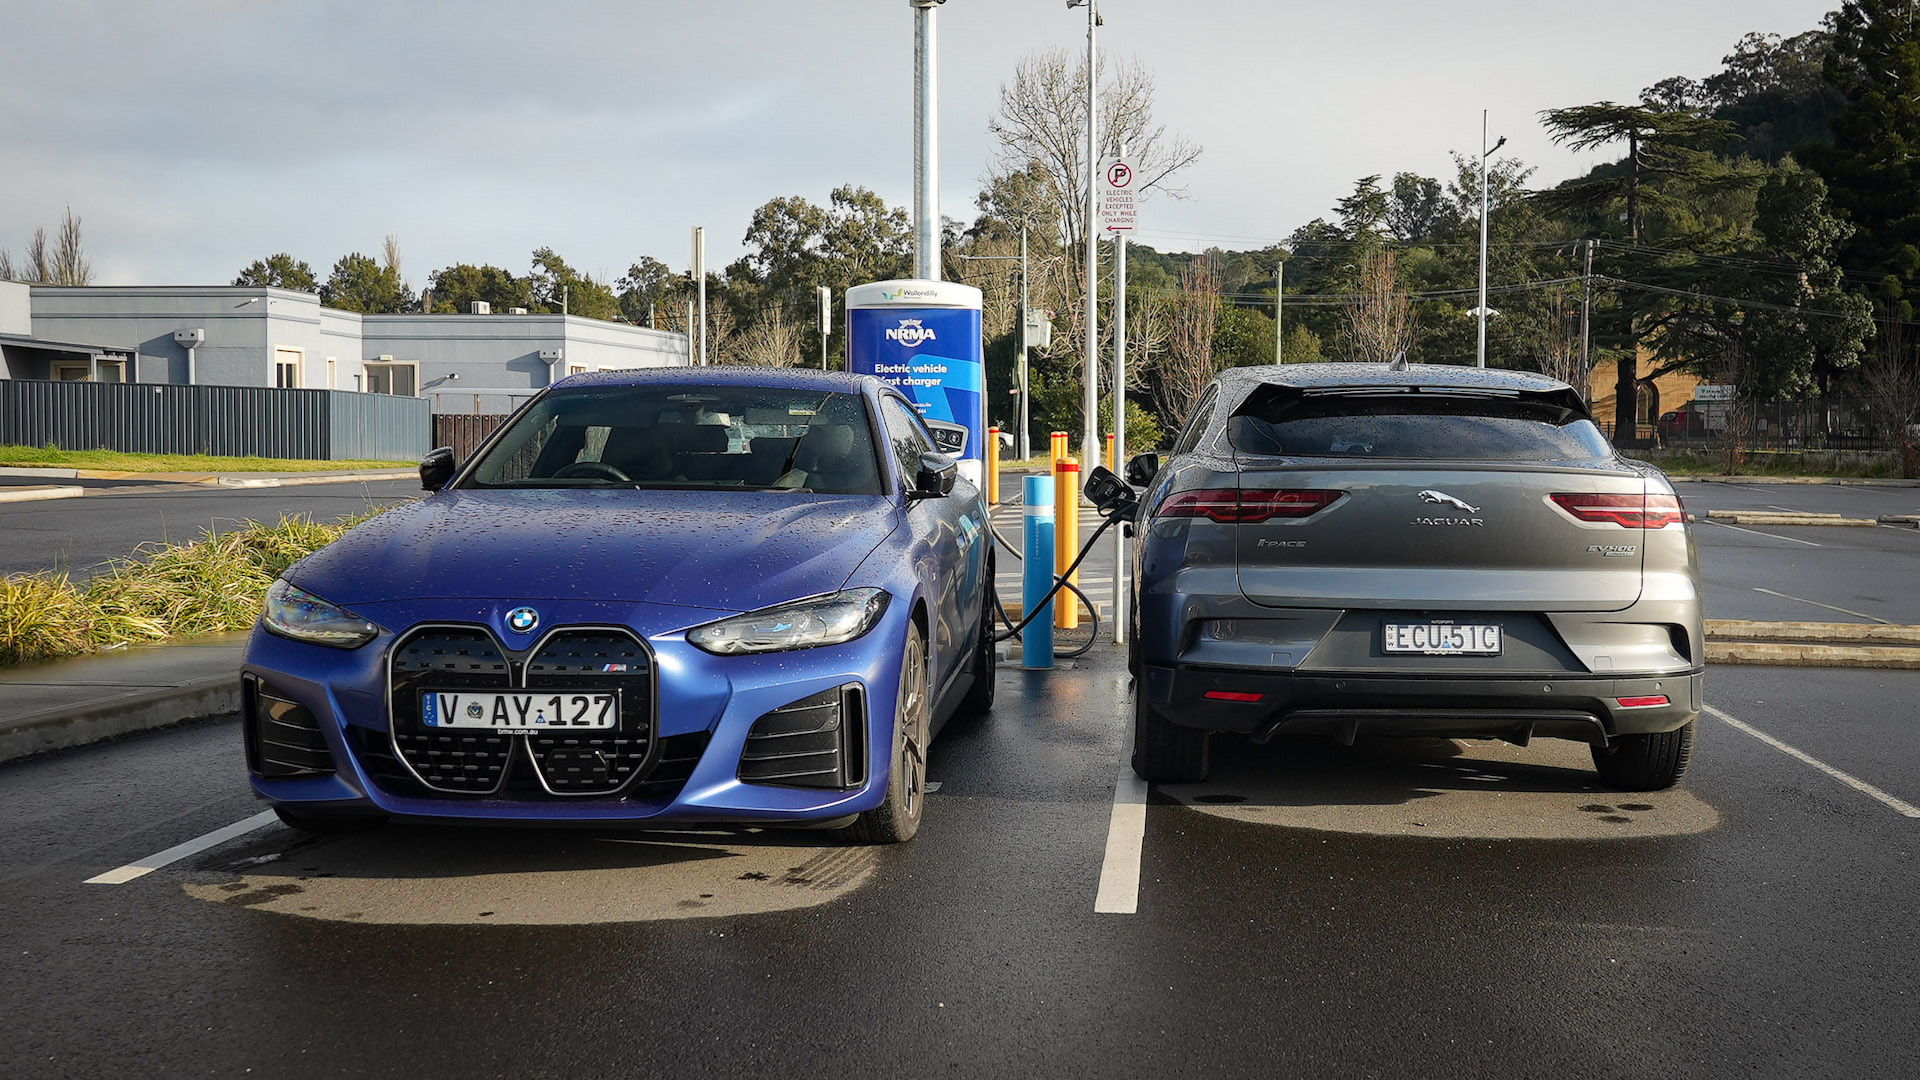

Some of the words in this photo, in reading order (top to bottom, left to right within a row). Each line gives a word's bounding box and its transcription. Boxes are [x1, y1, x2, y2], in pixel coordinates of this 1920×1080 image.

[885, 328, 936, 340] NRMA
[874, 364, 911, 373] Electric
[912, 364, 948, 373] vehicle
[902, 376, 942, 387] charger
[1409, 517, 1484, 526] JAGUAR
[497, 728, 539, 736] bmw.com.au
